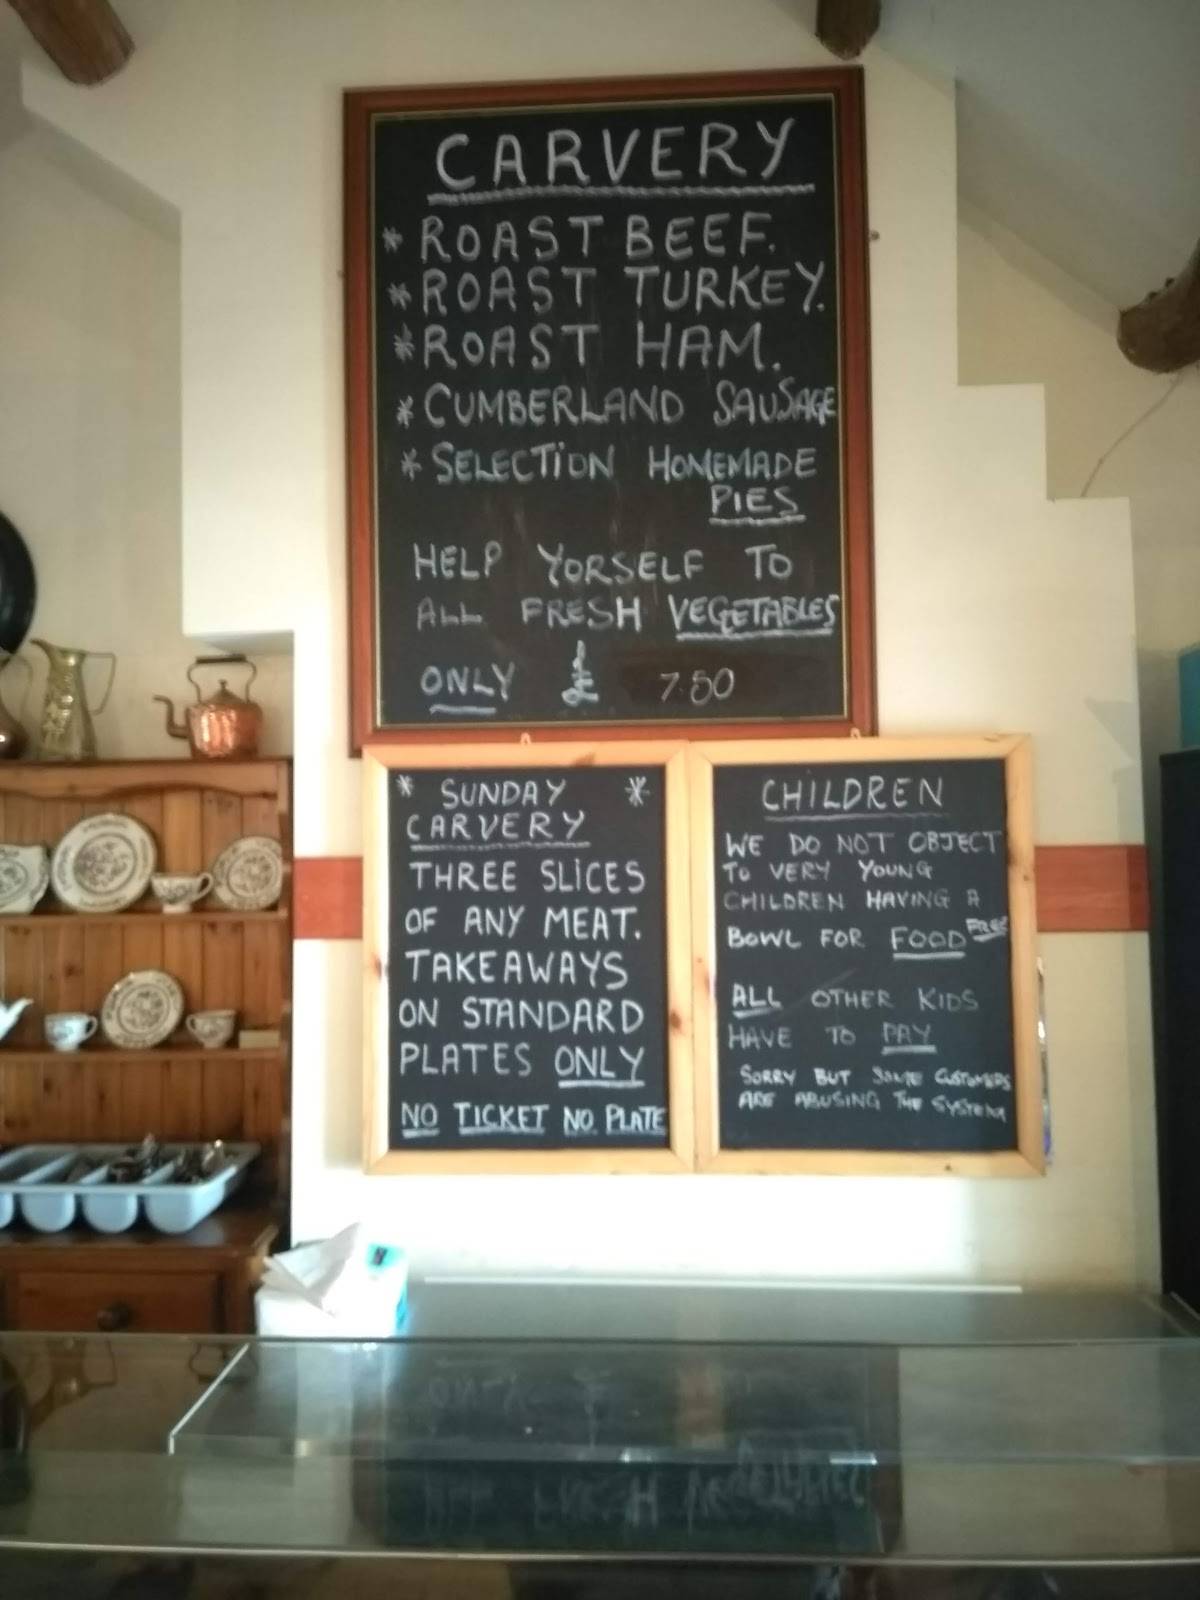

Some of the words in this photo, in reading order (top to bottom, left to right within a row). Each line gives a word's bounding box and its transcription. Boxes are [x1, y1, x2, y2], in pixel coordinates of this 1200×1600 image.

[435, 118, 796, 190] CARVERY
[420, 216, 603, 262] ROAST
[625, 212, 777, 260] BEEF.
[422, 267, 598, 314] ROAST
[624, 261, 826, 313] TURKEY.
[423, 325, 600, 369] ROAST
[637, 322, 783, 370] HAM.
[424, 383, 685, 429] CUMBERLAND
[713, 378, 837, 427] SAUSAGE
[648, 445, 818, 483] HOMEMADE
[710, 484, 801, 515] PIES
[413, 541, 502, 581] HELP
[537, 542, 704, 586] YORSELF
[745, 544, 793, 581] TO
[416, 598, 483, 630] ALL
[520, 597, 642, 632] FRESH
[668, 594, 840, 635] VEGETABLES
[420, 662, 516, 701] ONLY
[561, 639, 599, 705] £
[440, 779, 567, 809] SUNDAY
[762, 776, 943, 810] CHILDREN
[406, 810, 586, 841] CARVERY
[725, 832, 764, 857] WE
[790, 833, 821, 855] DO
[838, 832, 894, 854] NOT
[908, 831, 1002, 854] OBJECT
[409, 860, 517, 892] THREE
[540, 858, 646, 894] SLICES
[770, 862, 831, 882] VERY
[858, 860, 933, 882] YOUNG
[724, 890, 845, 910] CHILDREN
[866, 888, 950, 910] HAVING
[966, 889, 980, 907] A
[405, 906, 438, 935] OF
[464, 906, 525, 939] ANY
[544, 906, 642, 940] MEAT.
[727, 928, 802, 948] BOWL
[820, 928, 865, 948] FOR
[890, 926, 967, 950] FOOD
[405, 949, 628, 990] TAKEAWAYS
[732, 983, 782, 1008] ALL
[810, 988, 894, 1010] OTHER
[918, 988, 979, 1011] KIDS
[399, 999, 438, 1028] ON
[462, 997, 645, 1034] STANDARD
[727, 1024, 793, 1050] HAVE
[824, 1026, 856, 1046] TO
[882, 1022, 932, 1045] PAY
[401, 1043, 532, 1076] PLATES
[555, 1045, 645, 1082] ONLY
[739, 1064, 797, 1086] SORRY
[813, 1068, 852, 1086] BUT
[401, 1102, 438, 1127] NO
[453, 1102, 549, 1133] TICKET
[563, 1106, 594, 1132] NO
[605, 1104, 666, 1133] PLATE
[738, 1091, 776, 1110] ARE
[794, 1091, 881, 1110] ABUSING
[893, 1090, 923, 1112] THE
[932, 1096, 1006, 1123] SYSTEM
